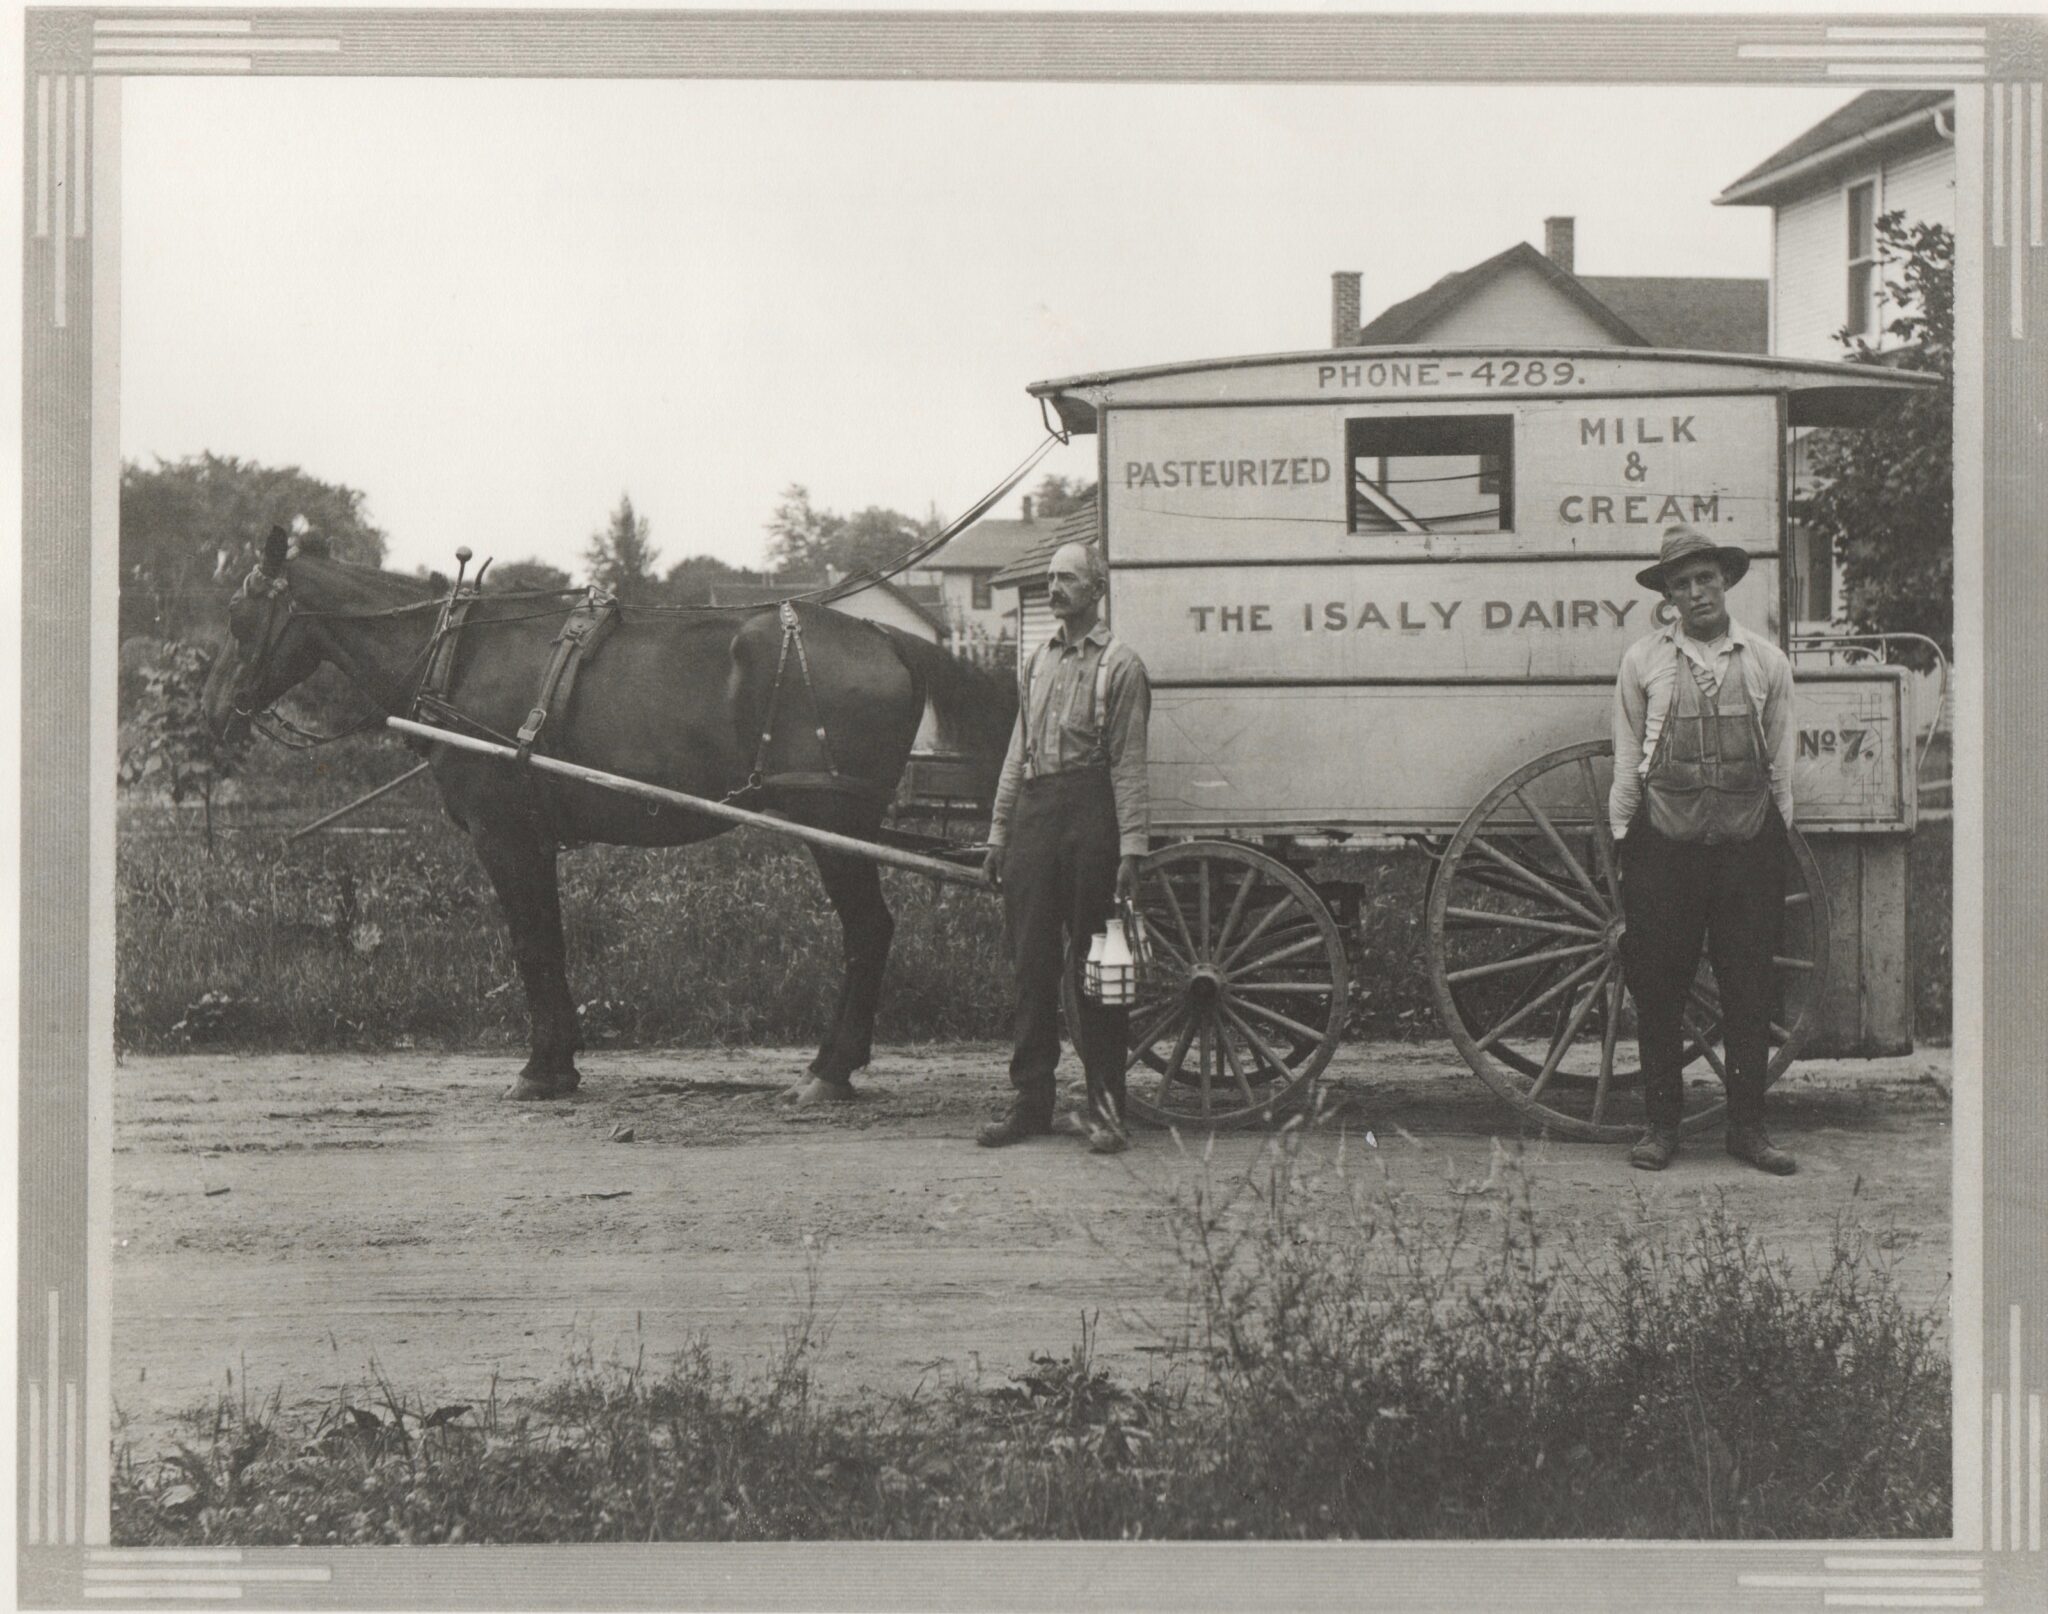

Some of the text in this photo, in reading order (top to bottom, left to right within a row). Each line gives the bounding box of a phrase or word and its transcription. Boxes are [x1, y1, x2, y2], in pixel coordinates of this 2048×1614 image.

[1318, 359, 1586, 389] PHONE-4289.
[1580, 415, 1698, 446] MILK
[1126, 457, 1331, 489] PASTEURIZED
[1625, 452, 1648, 482] &
[1559, 493, 1734, 525] CREAM.
[1189, 604, 1273, 633] THE
[1302, 600, 1463, 632] ISALY
[1483, 599, 1638, 630] DAIRY
